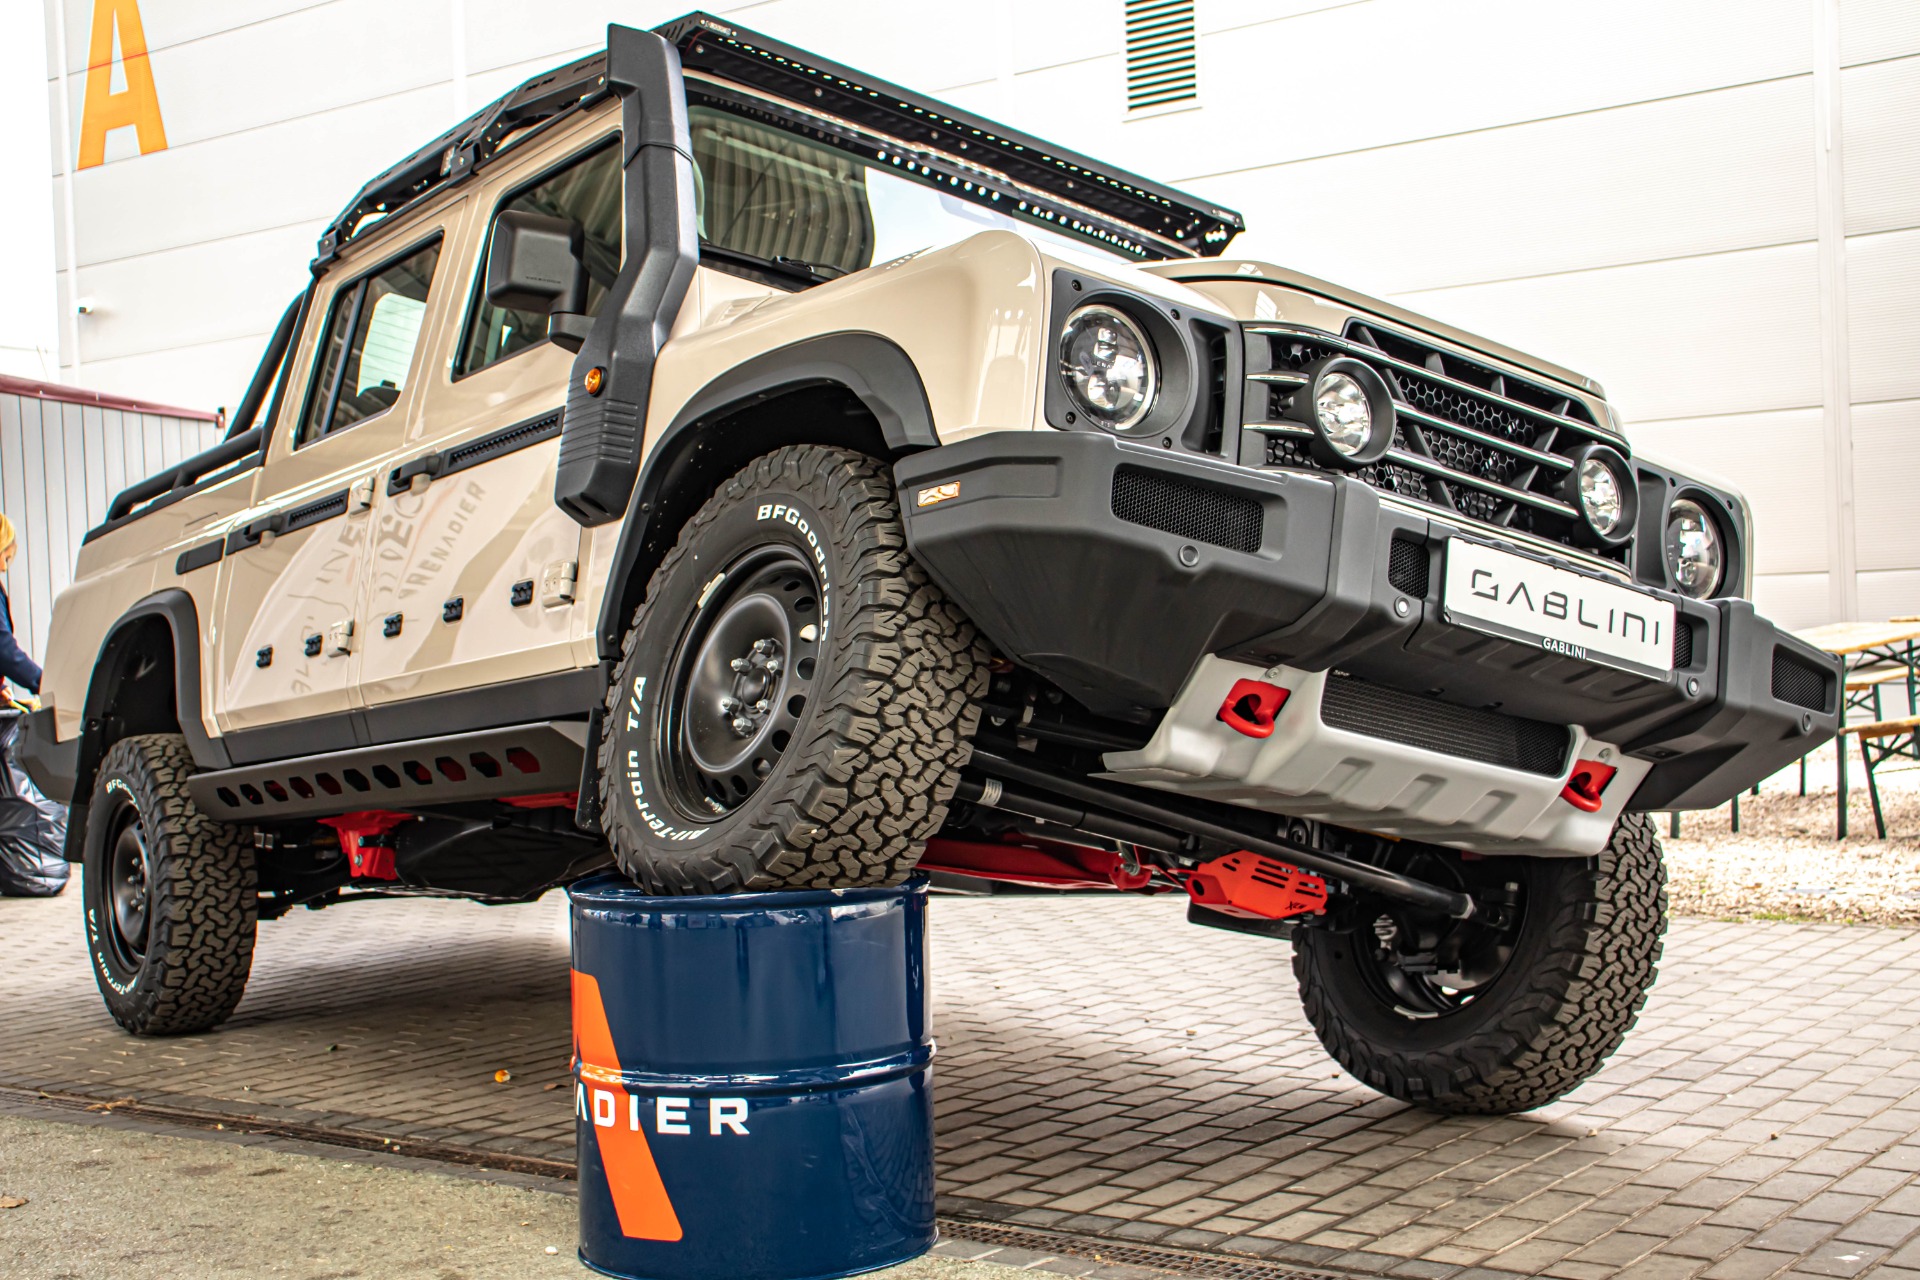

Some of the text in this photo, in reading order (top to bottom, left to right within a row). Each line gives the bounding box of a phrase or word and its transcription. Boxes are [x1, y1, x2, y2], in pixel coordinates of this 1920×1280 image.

[77, 0, 169, 171] A
[757, 504, 830, 642] BFGoodrich
[1471, 569, 1660, 646] GABLINI
[1542, 637, 1587, 660] GABLINI
[626, 676, 710, 841] All-Terrain T/A
